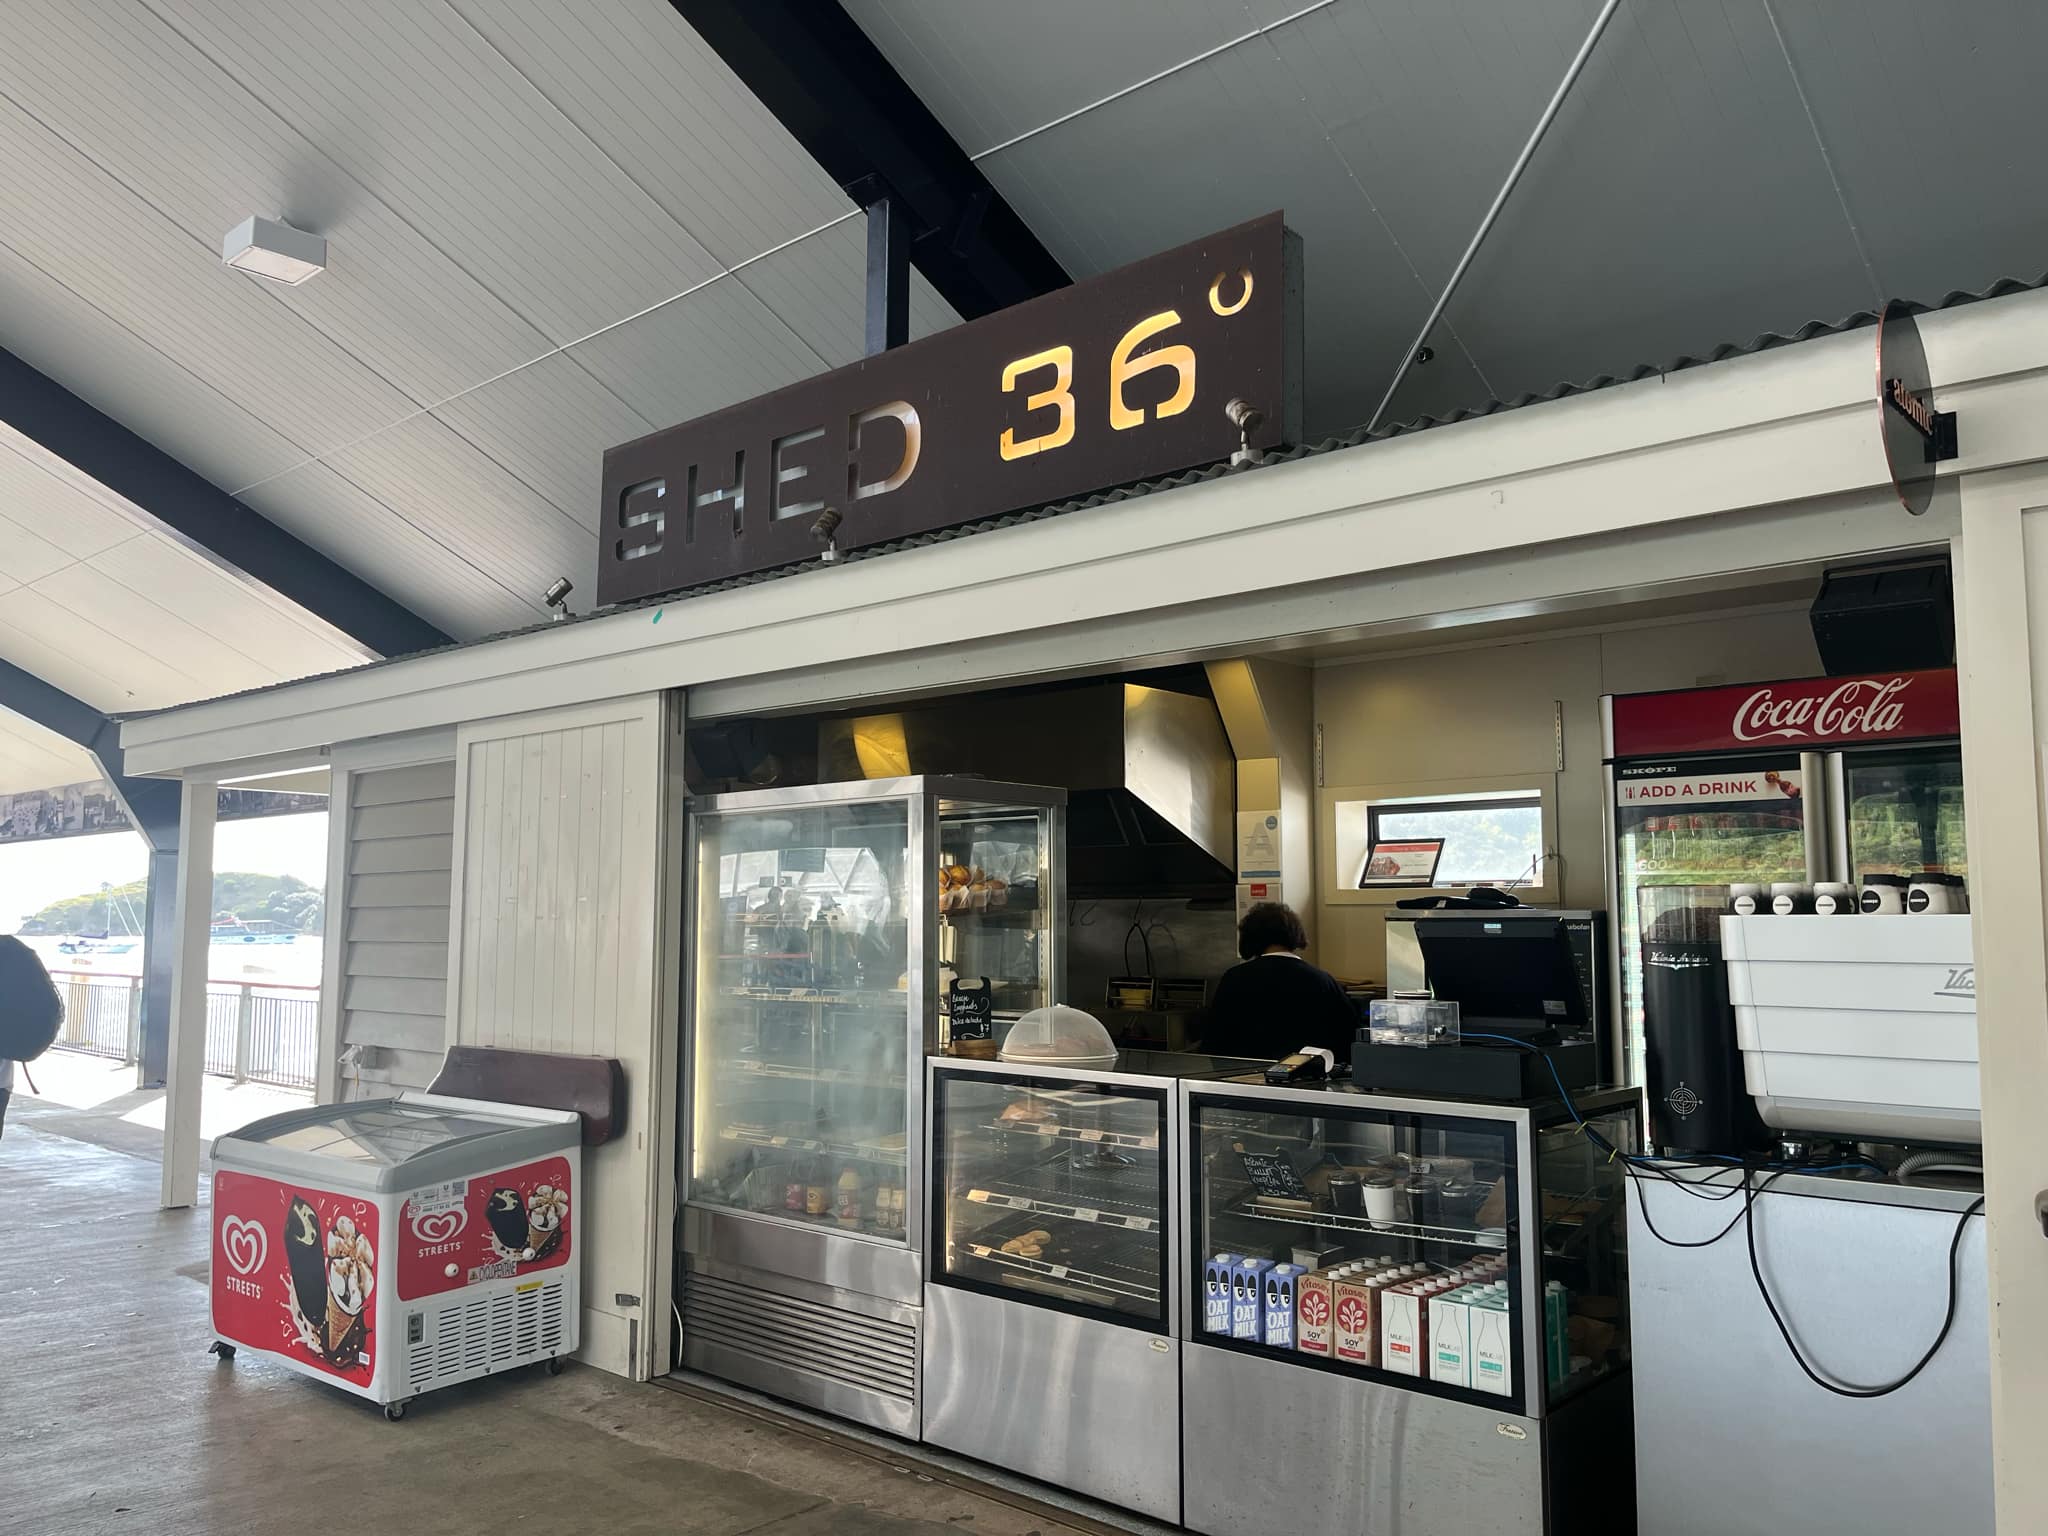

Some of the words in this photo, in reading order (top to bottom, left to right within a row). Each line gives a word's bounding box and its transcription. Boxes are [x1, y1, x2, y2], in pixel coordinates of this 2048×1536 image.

[616, 400, 922, 562] SHED
[1732, 677, 1914, 741] Coca-Cola
[1622, 766, 1677, 775] SKOPE
[1639, 783, 1677, 798] ADD
[1681, 783, 1694, 797] A
[1699, 780, 1757, 796] DRINK
[418, 1241, 462, 1258] STREETS
[226, 1275, 262, 1300] STREETS
[1207, 1299, 1229, 1317] OAT
[1233, 1304, 1257, 1322] OAT
[1206, 1314, 1229, 1333] MILK
[1233, 1320, 1257, 1338] MILK
[1267, 1311, 1290, 1329] OAT
[1266, 1327, 1290, 1345] MILK
[1307, 1331, 1321, 1339] SOY
[1344, 1338, 1359, 1347] SOY
